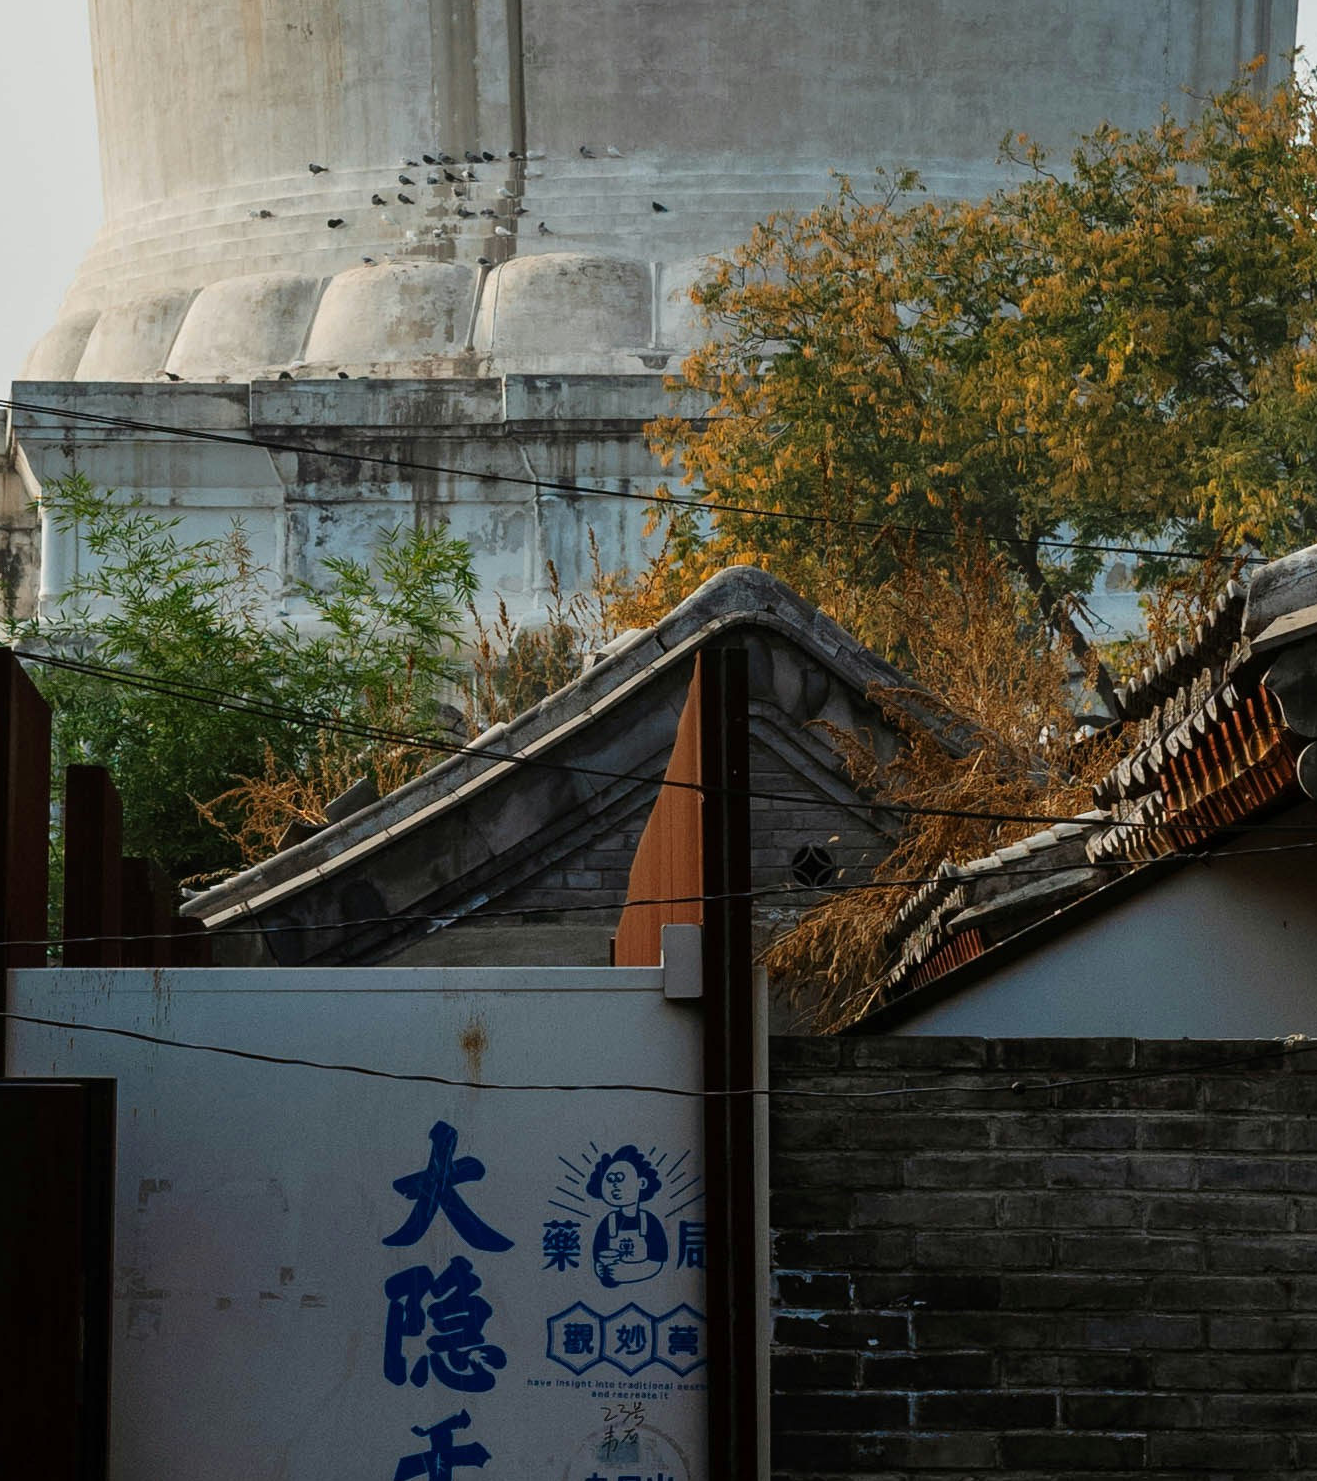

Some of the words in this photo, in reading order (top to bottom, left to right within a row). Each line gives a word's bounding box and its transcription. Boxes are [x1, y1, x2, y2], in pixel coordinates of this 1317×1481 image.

[527, 1378, 552, 1388] have
[556, 1379, 592, 1390] insight
[595, 1380, 615, 1389] into
[618, 1381, 674, 1391] traditional
[591, 1390, 610, 1398] and
[612, 1391, 657, 1400] recreate
[660, 1391, 669, 1400] it
